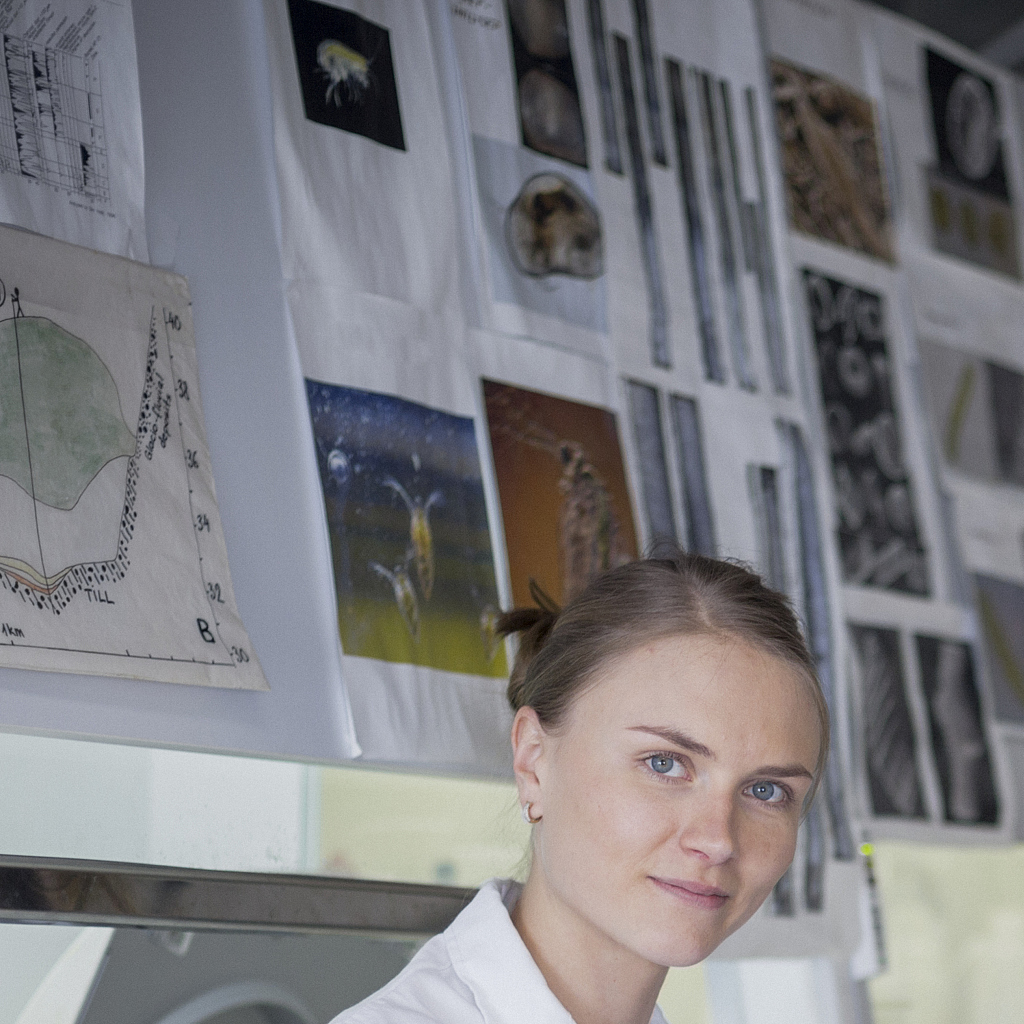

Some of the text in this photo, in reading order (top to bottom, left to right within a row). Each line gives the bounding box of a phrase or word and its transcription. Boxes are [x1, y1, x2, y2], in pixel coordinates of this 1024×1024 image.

[168, 312, 182, 331] 40
[186, 449, 199, 469] 36
[196, 513, 211, 533] 34
[207, 582, 225, 604] 32
[197, 617, 216, 644] B
[231, 645, 250, 663] 30
